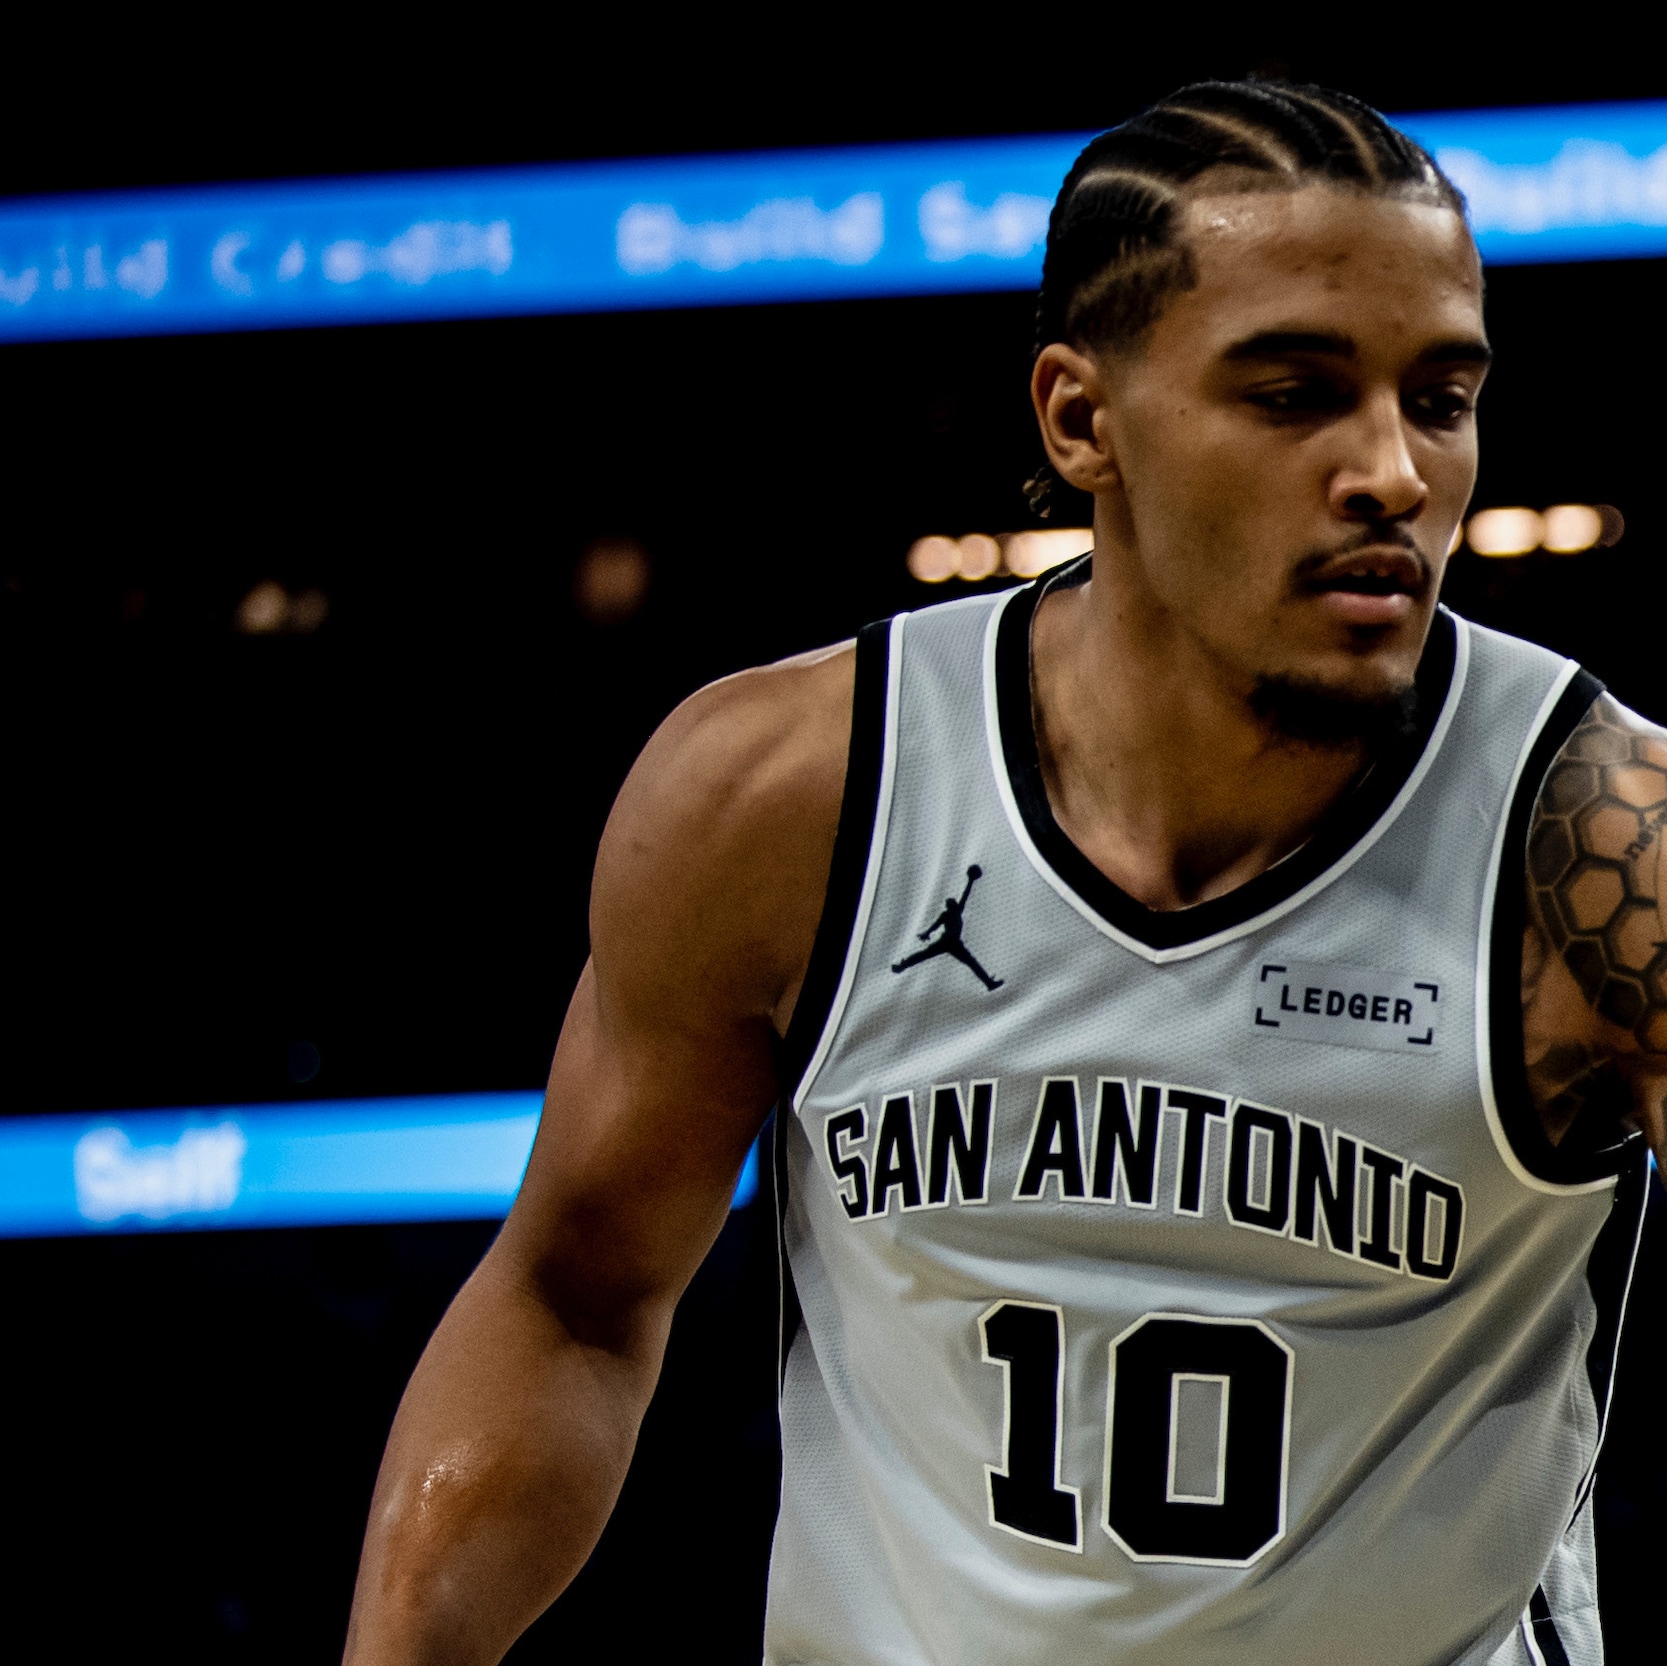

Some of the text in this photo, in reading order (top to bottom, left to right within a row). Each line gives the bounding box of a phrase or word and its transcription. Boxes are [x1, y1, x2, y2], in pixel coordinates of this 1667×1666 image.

[0, 238, 169, 306] uild
[1280, 984, 1413, 1026] LEDGER
[825, 1075, 1464, 1283] SAN ANTONIO
[976, 1298, 1296, 1568] 10
